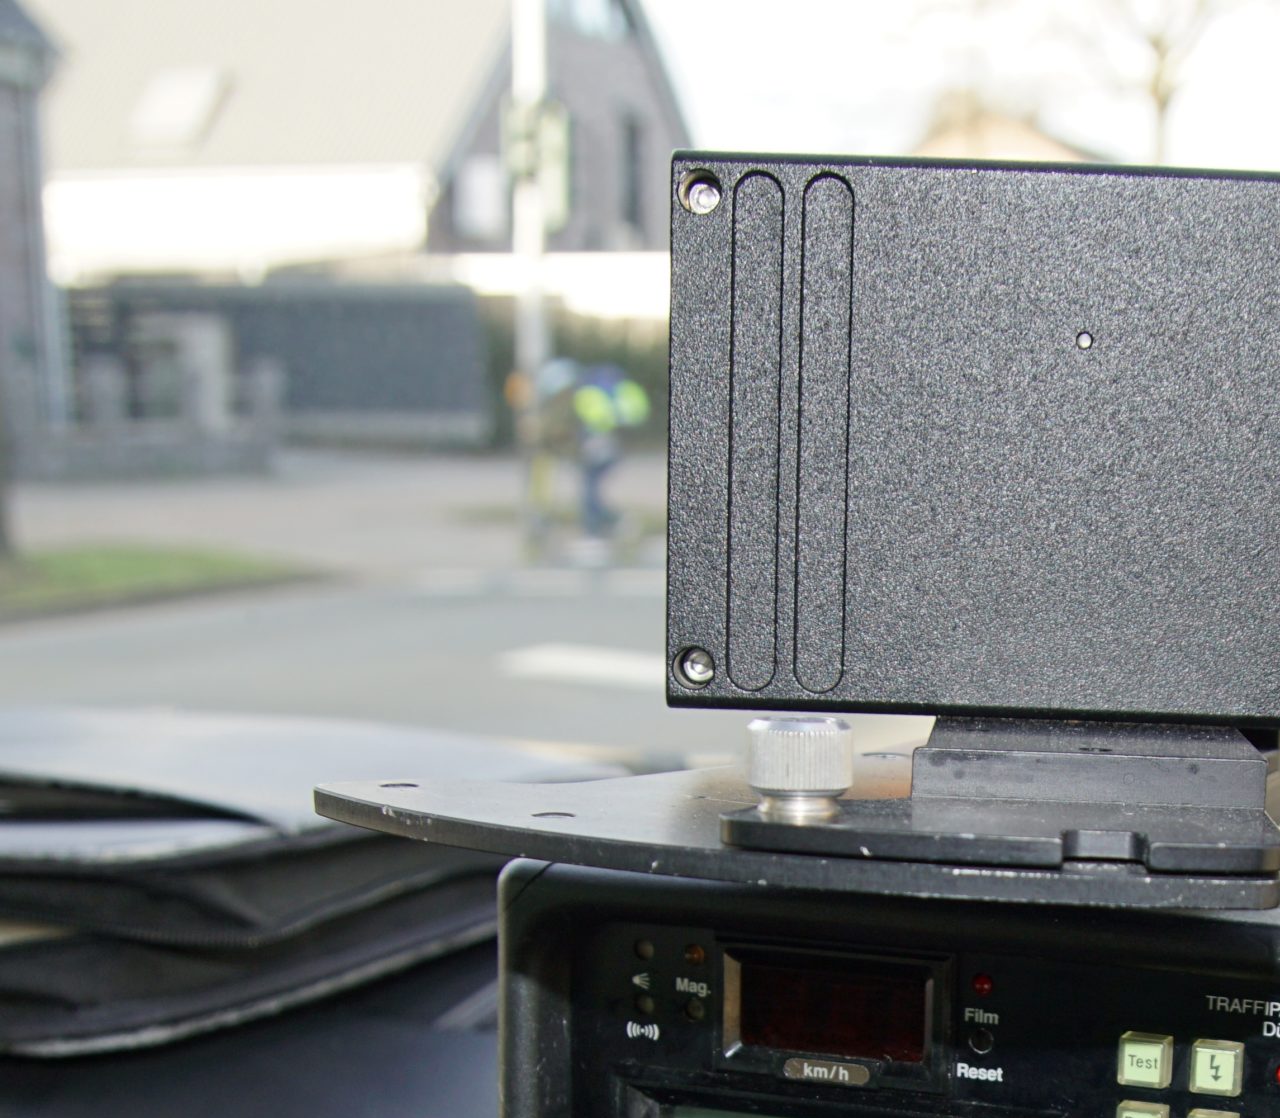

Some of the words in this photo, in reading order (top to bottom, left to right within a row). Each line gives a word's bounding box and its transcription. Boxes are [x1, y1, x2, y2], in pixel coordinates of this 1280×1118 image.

[675, 977, 711, 997] Mag.
[964, 1007, 999, 1025] Film
[803, 1062, 849, 1081] km/h
[1128, 1054, 1158, 1070] Test
[956, 1062, 1003, 1082] Reset
